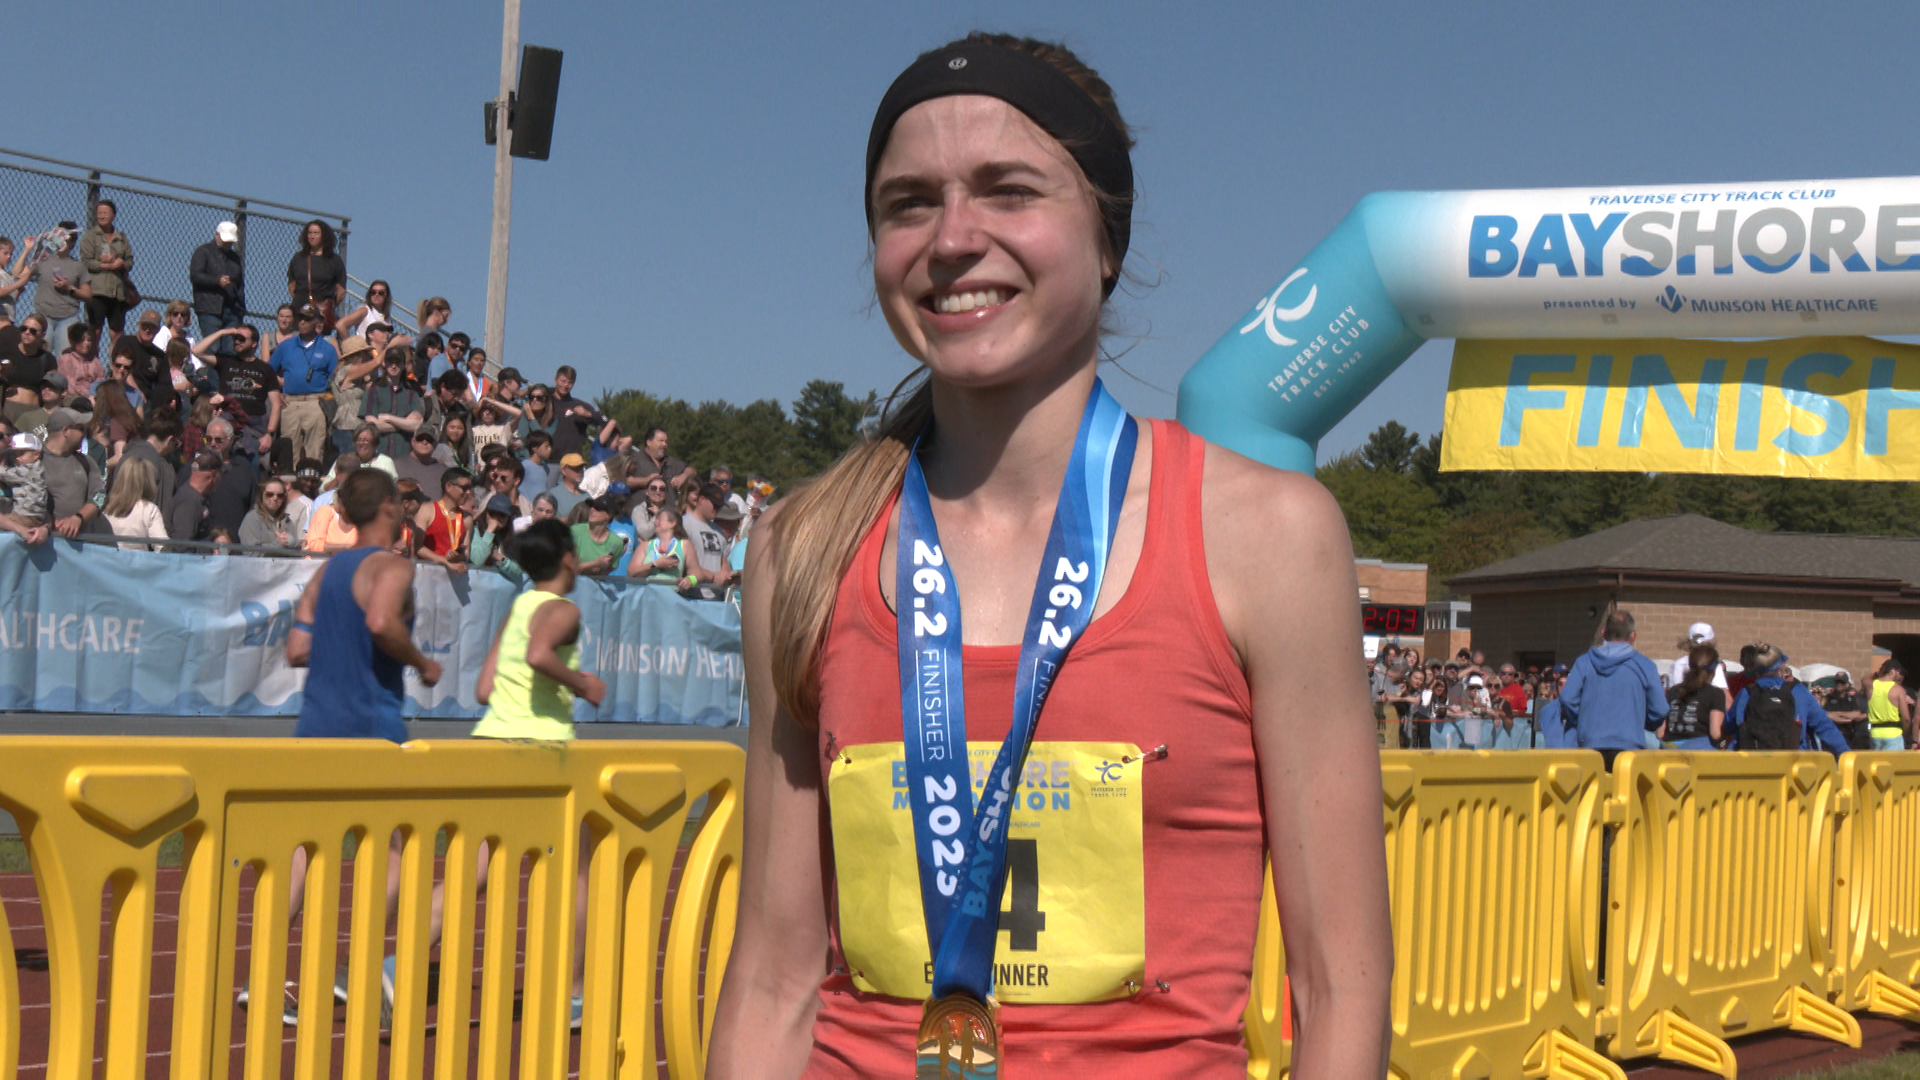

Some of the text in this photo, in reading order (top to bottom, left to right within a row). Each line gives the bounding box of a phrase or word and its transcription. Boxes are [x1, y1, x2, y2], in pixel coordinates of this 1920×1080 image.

[1589, 188, 1836, 206] TRAVERSE CITY TRACK CLUB
[1468, 204, 1920, 279] BAYSHORE
[1267, 305, 1356, 392] TRAVERSE CITY
[1543, 297, 1879, 313] presented by MUNSON HEALTHCARE
[1281, 318, 1369, 402] TRACK CLUB
[1499, 352, 1920, 457] FINISH
[913, 539, 948, 637] 26.2
[1038, 557, 1089, 650] 26.2
[595, 637, 745, 680] MUNSON HEAL
[922, 649, 945, 761] FINISHER
[961, 765, 1012, 919] BAYSHO
